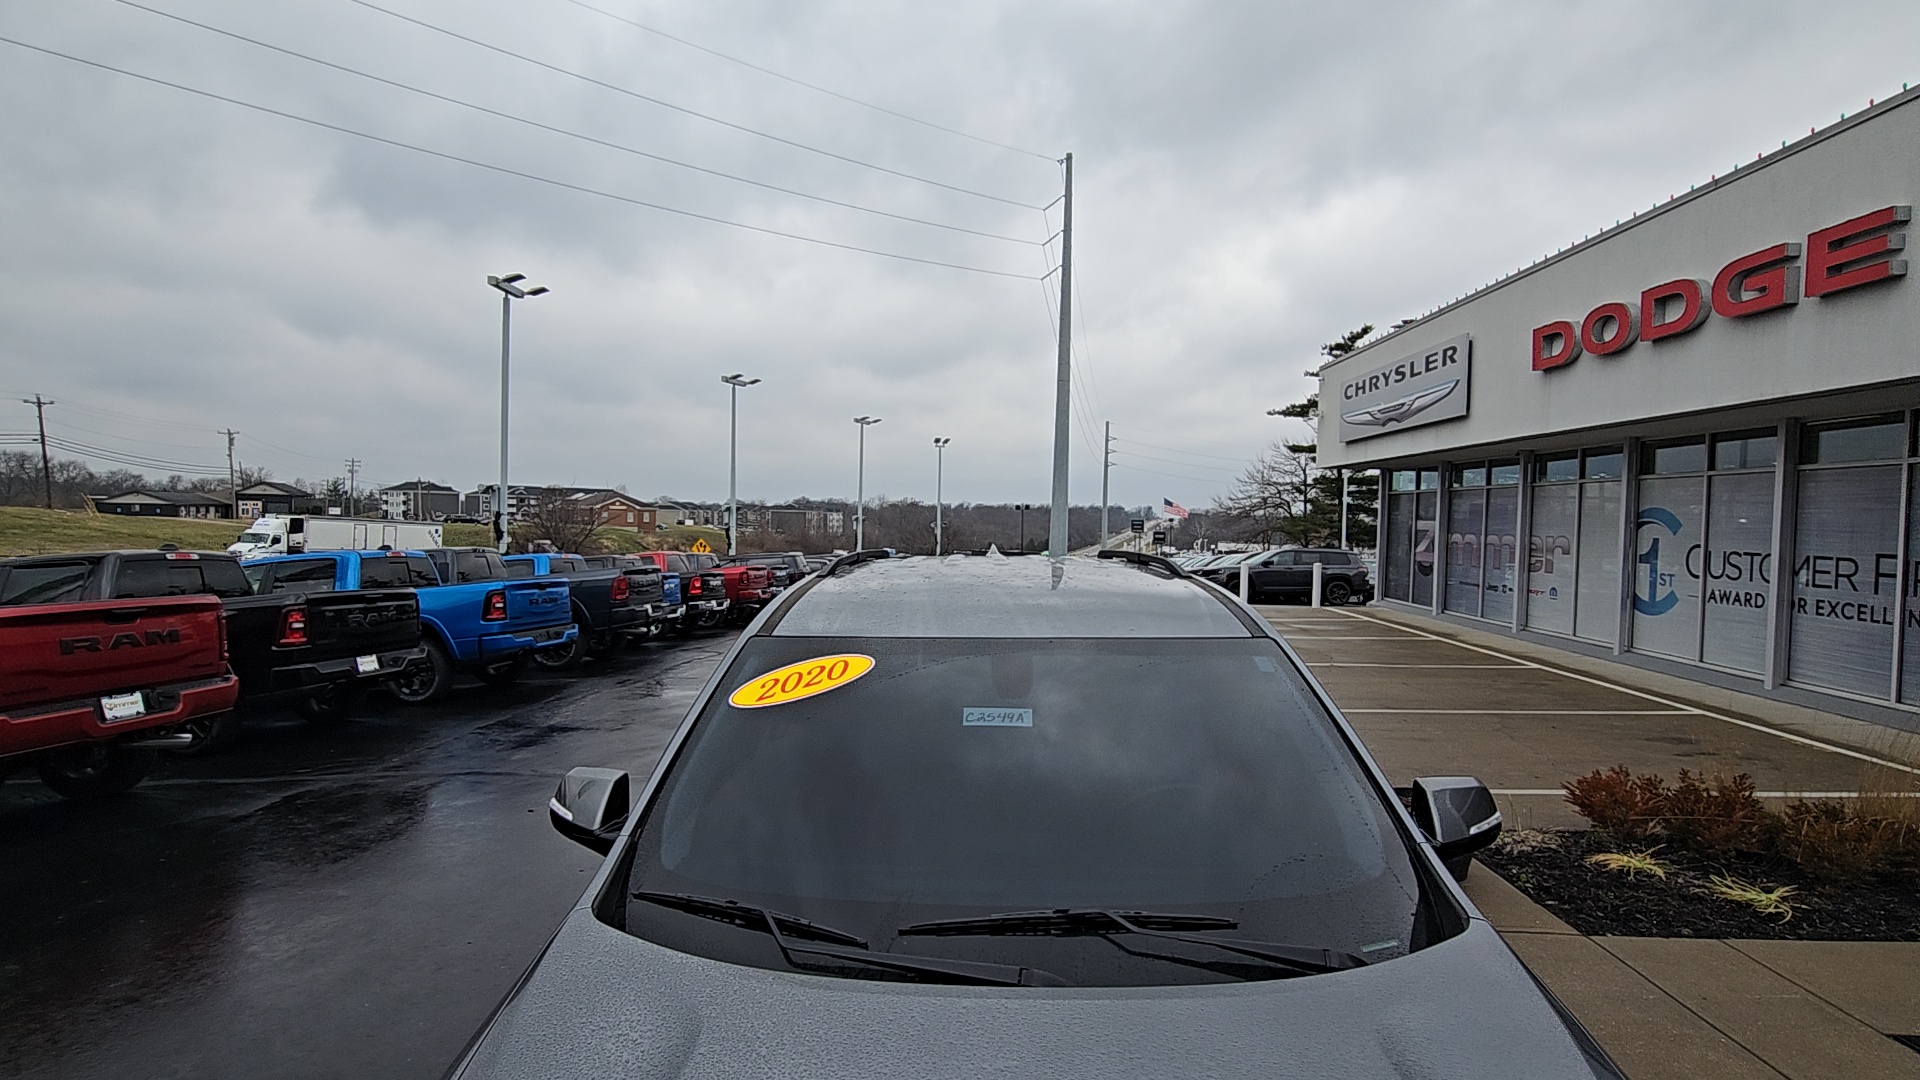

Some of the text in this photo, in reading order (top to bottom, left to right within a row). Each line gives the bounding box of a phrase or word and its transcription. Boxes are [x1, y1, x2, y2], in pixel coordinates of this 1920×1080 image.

[1531, 205, 1911, 372] DODGE
[1343, 345, 1458, 400] CHRYSLER
[1410, 520, 1571, 575] Zmmer
[1873, 553, 1920, 598] FI
[528, 596, 559, 606] RAM
[1707, 588, 1766, 609] AWARD
[1815, 598, 1920, 628] EXCELLN
[60, 628, 180, 655] RAM
[755, 659, 850, 703] 2020
[965, 711, 1025, 723] C2549A
